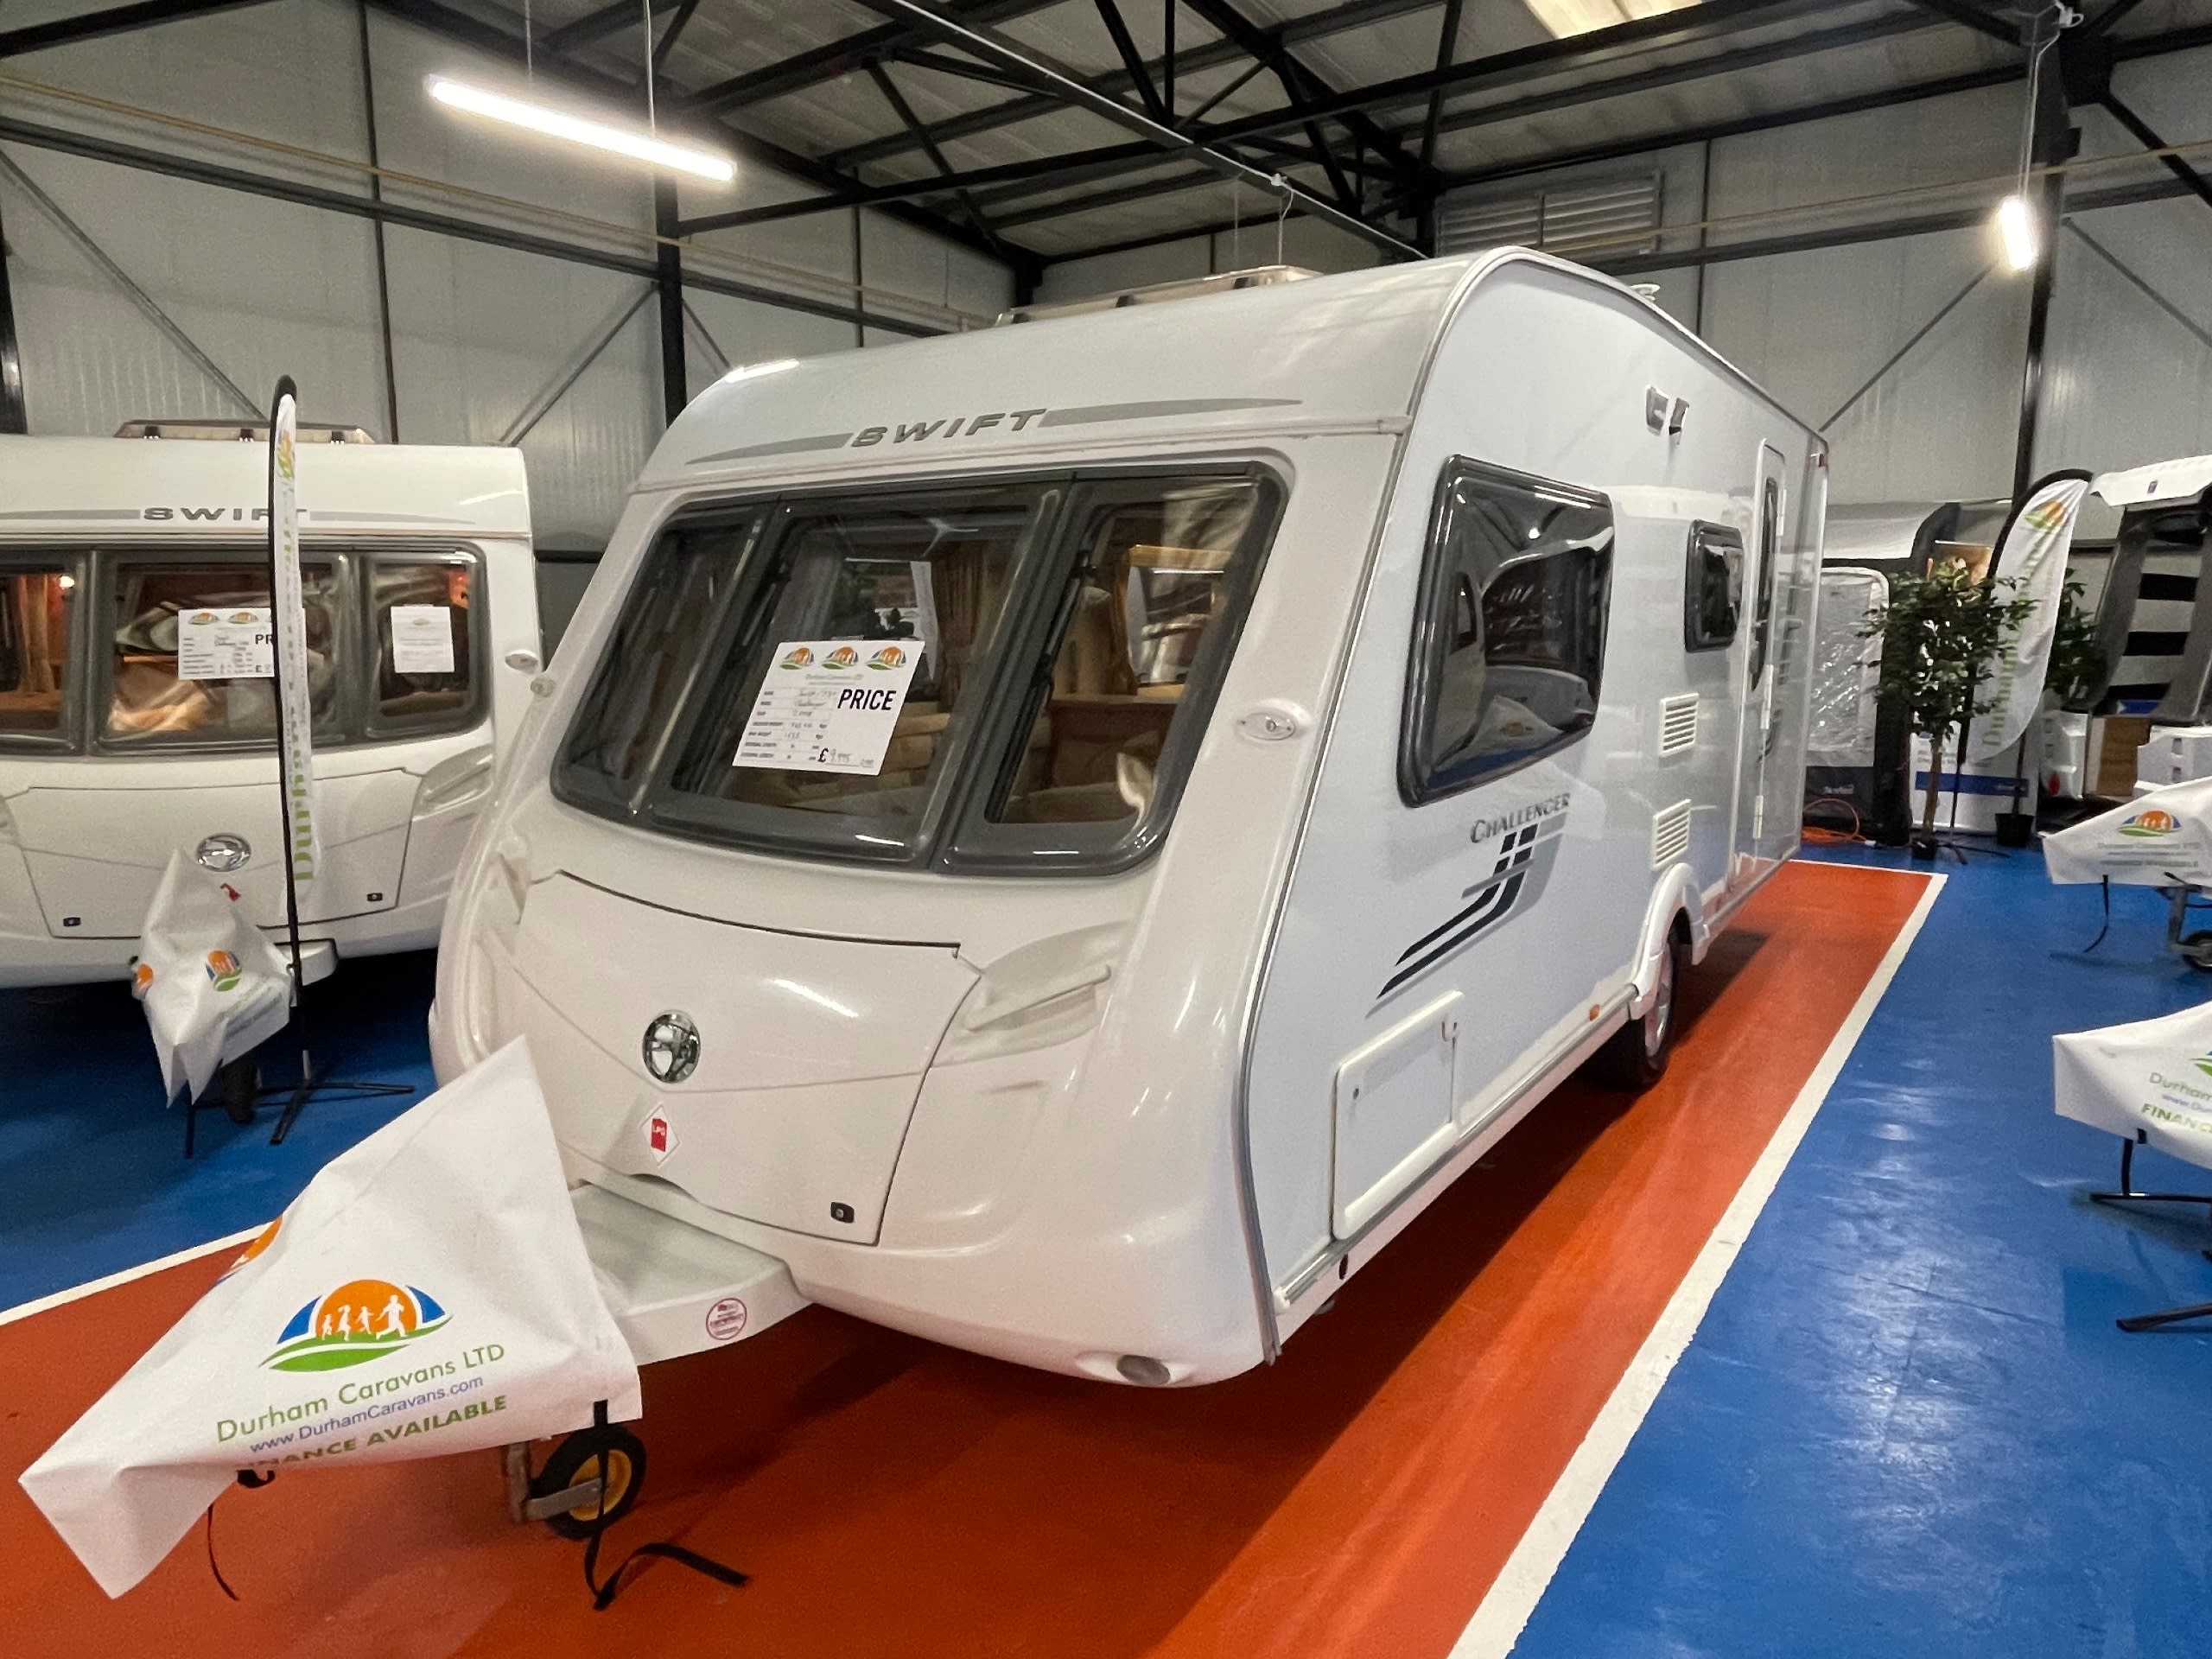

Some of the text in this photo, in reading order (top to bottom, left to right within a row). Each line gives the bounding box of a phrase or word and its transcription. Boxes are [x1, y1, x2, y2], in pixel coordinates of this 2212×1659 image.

[851, 408, 1046, 448] SWIFT
[143, 507, 307, 520] SWIF
[837, 689, 897, 710] PRICE
[217, 1343, 505, 1443] Durham Caravans LTD
[233, 1395, 508, 1466] NANCE AVAILABLE
